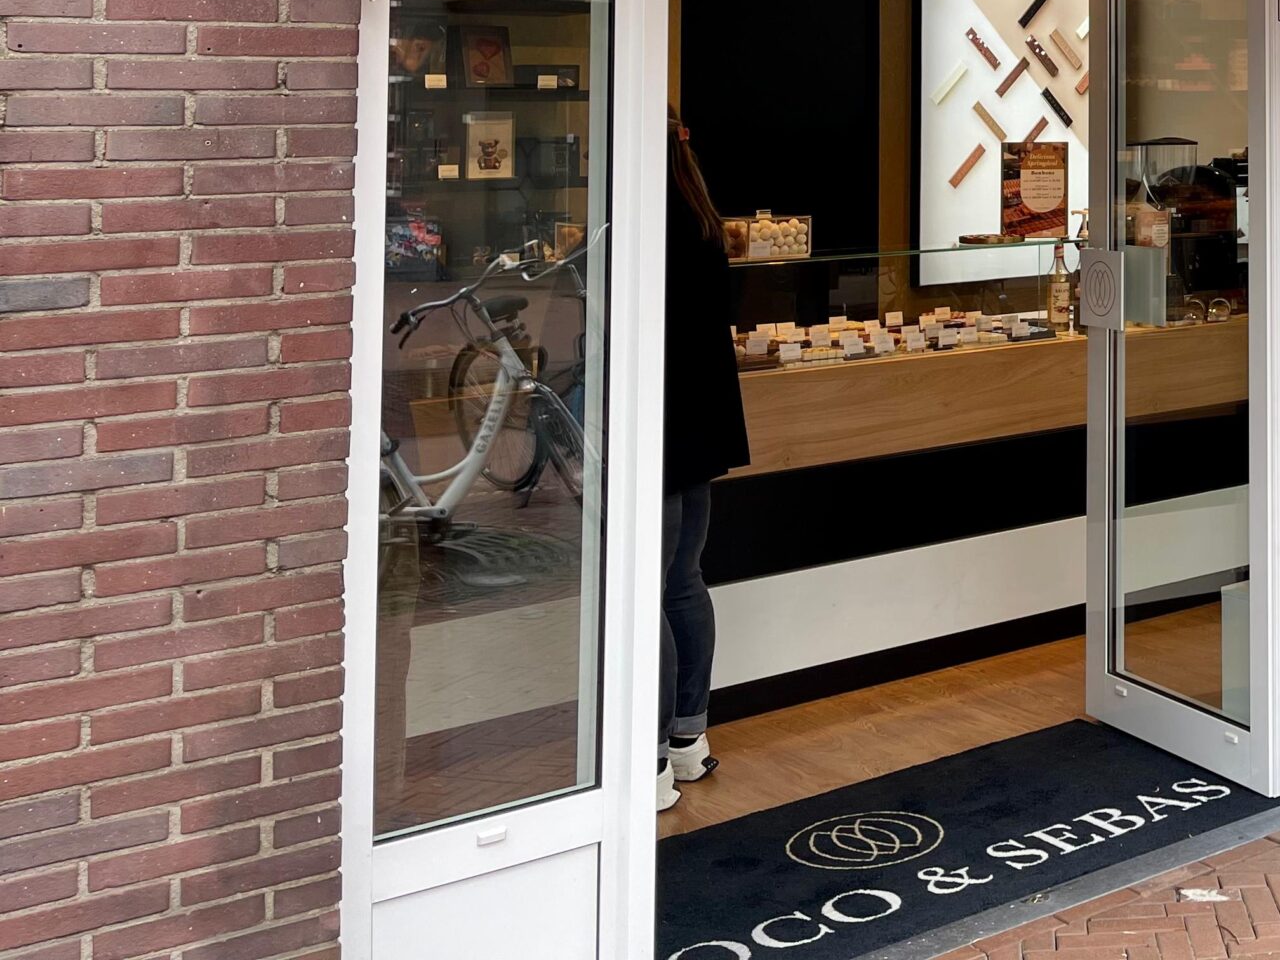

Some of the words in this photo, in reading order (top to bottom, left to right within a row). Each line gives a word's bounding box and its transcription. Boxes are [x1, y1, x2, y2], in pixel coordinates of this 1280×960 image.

[667, 889, 902, 960] OCO
[917, 866, 994, 894] &
[986, 778, 1231, 870] SEBAS
